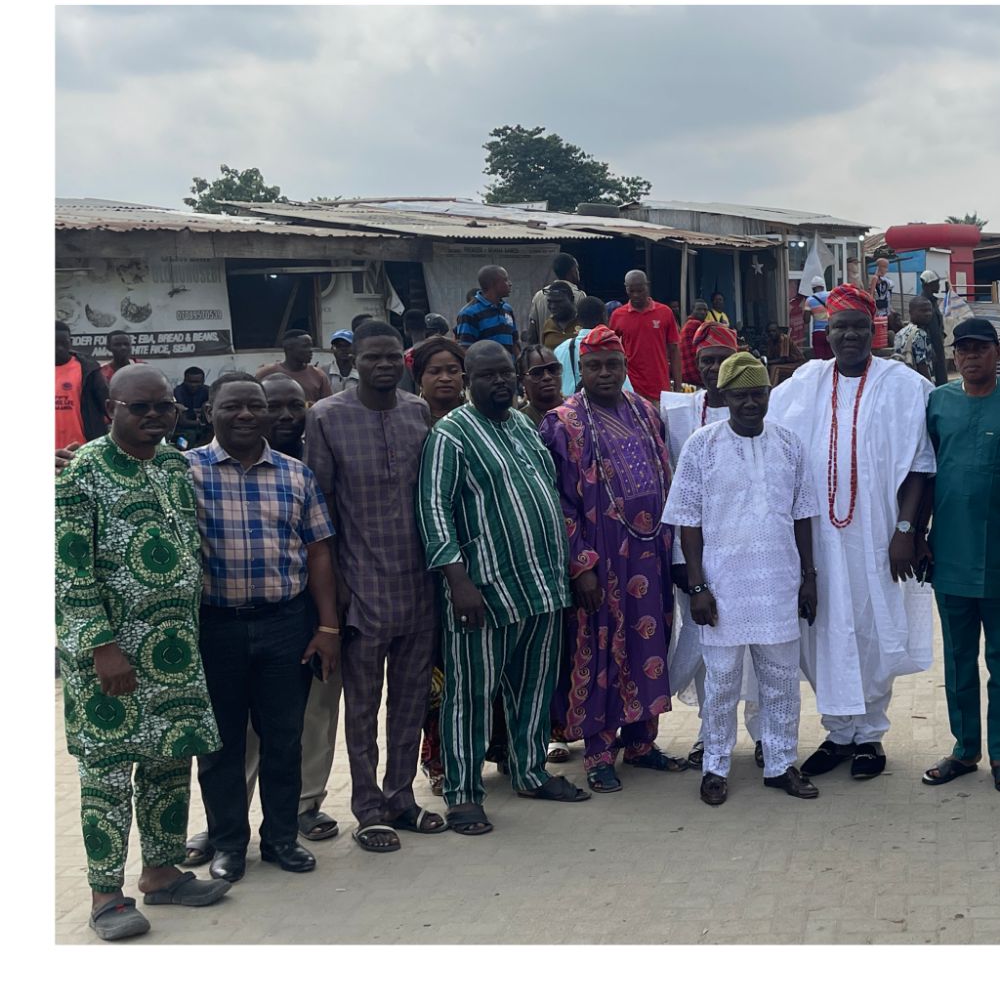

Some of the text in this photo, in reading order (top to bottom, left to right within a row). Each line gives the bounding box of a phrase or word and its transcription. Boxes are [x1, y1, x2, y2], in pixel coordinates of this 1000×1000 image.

[157, 333, 184, 343] BREAD
[185, 332, 191, 342] &
[131, 345, 149, 355] HITE
[172, 343, 196, 353] SEMO
